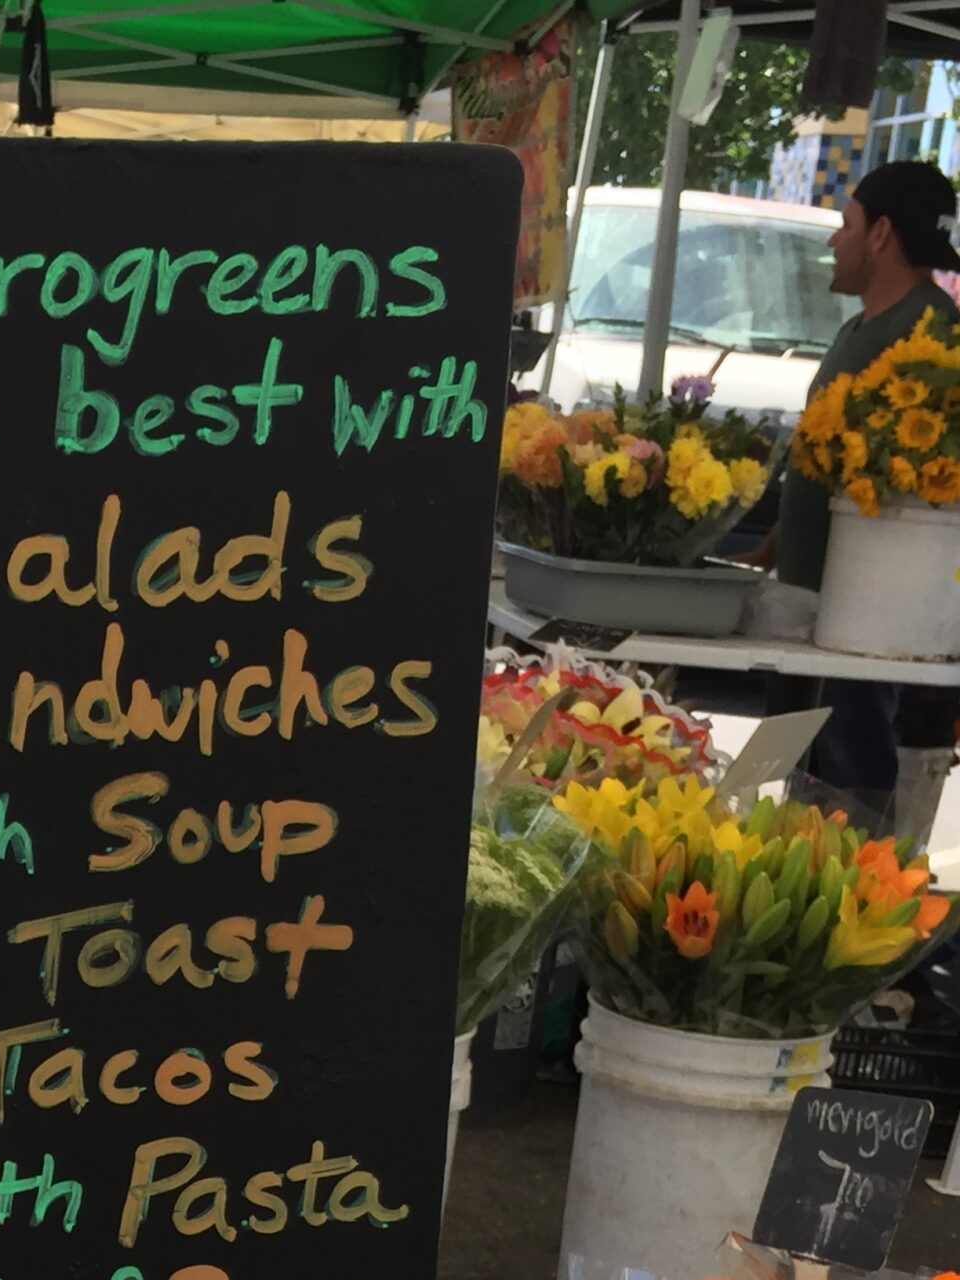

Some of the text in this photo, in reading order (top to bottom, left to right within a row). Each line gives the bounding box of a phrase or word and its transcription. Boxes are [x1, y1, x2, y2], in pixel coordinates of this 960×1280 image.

[54, 336, 306, 457] best
[333, 356, 488, 457] with
[88, 772, 338, 882] Soup
[8, 895, 353, 1006] Toast
[119, 1137, 409, 1247] Pasta
